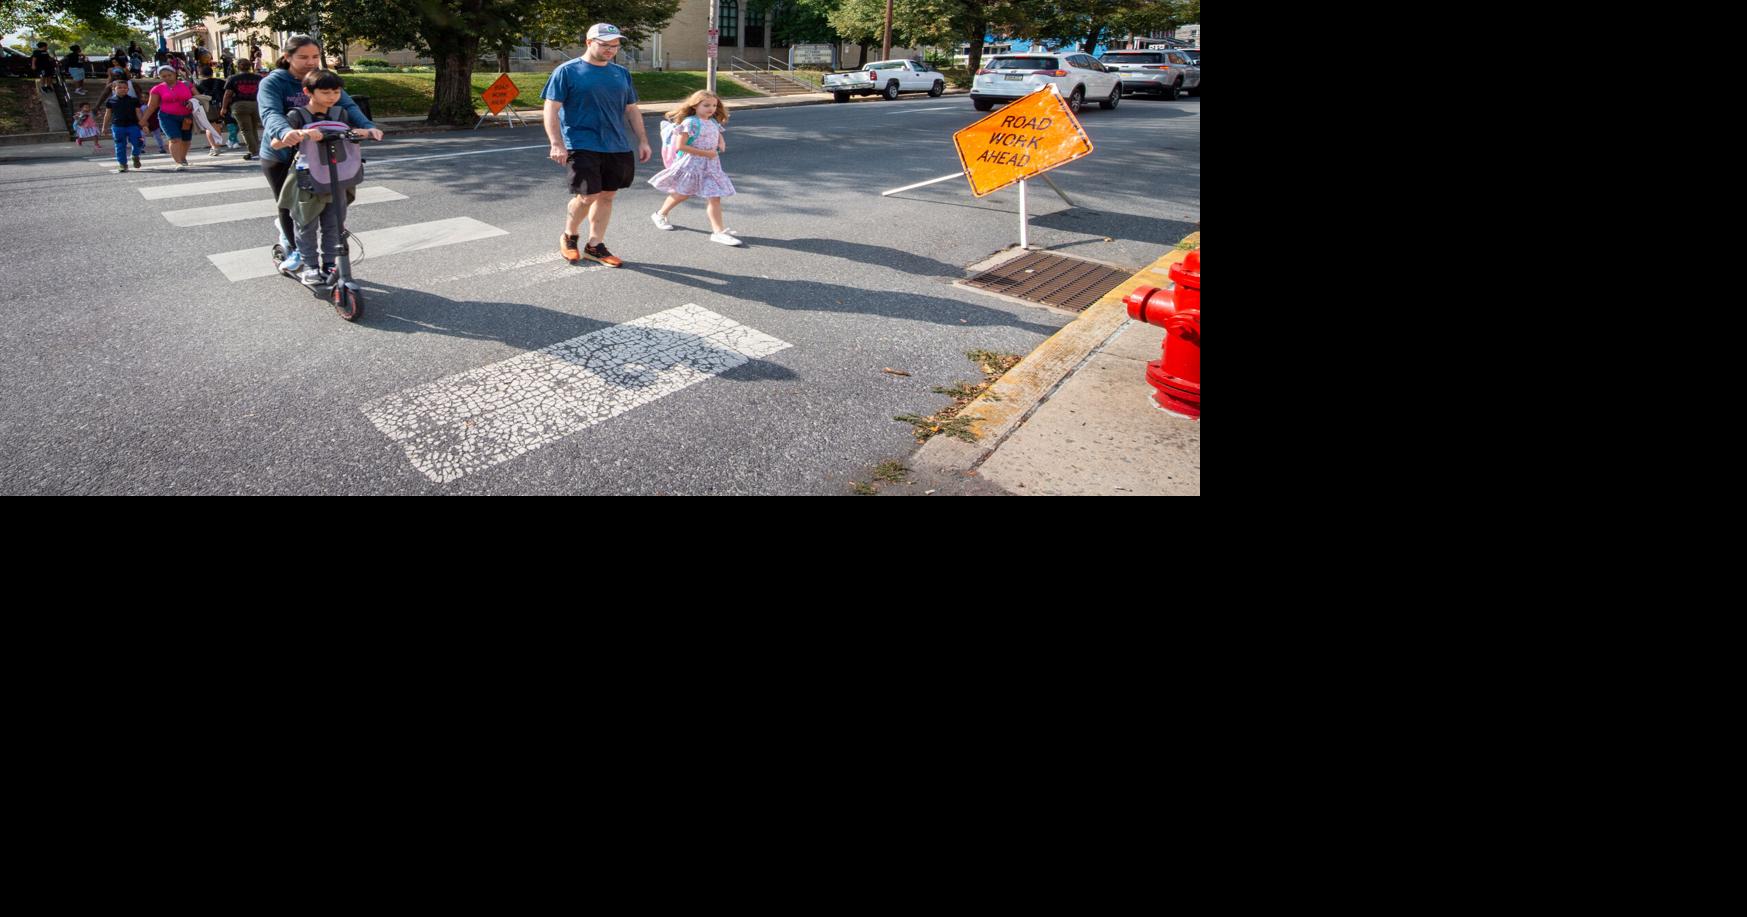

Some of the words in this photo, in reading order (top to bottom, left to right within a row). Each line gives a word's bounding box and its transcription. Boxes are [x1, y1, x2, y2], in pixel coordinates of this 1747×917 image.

[1000, 116, 1052, 131] ROAD
[989, 131, 1043, 149] WORK
[977, 149, 1031, 167] AHEAD
